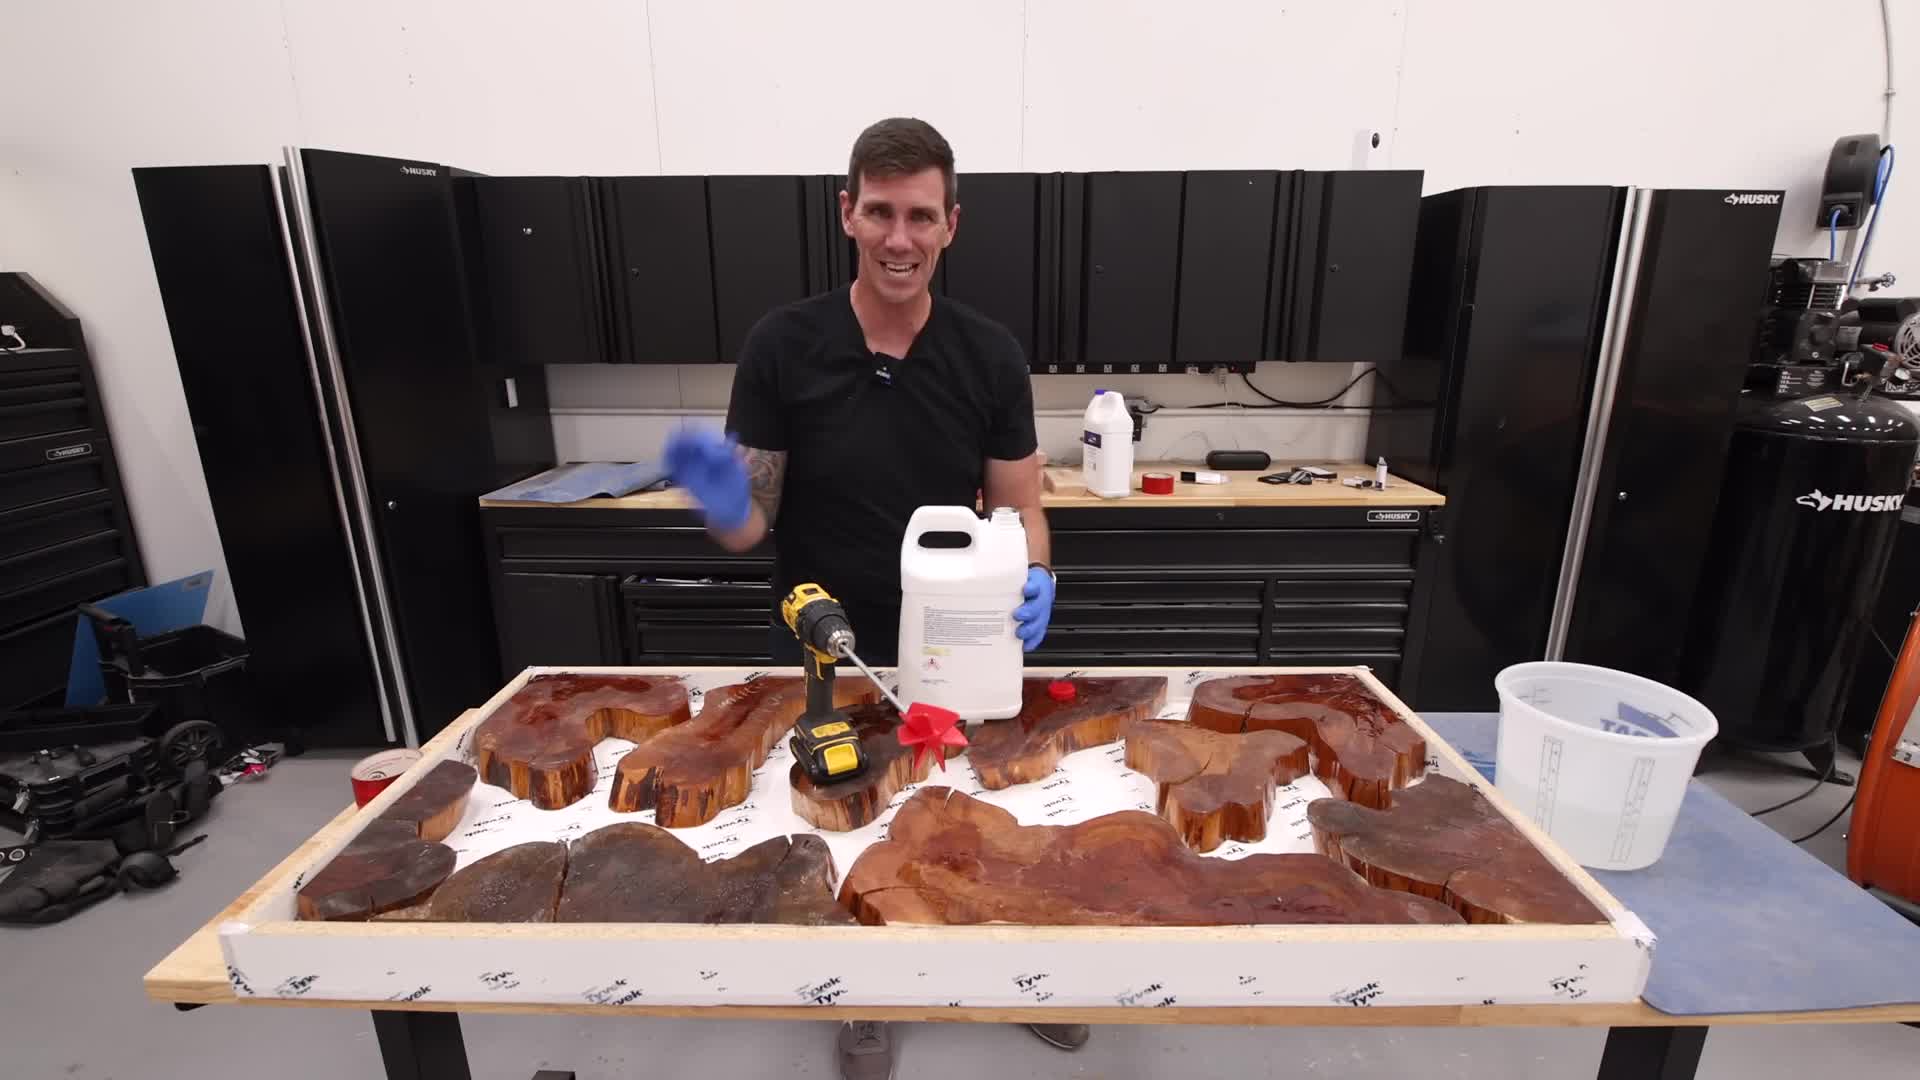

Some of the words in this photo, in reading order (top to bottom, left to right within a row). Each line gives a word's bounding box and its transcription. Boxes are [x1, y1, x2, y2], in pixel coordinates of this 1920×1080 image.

[409, 167, 437, 177] HUSKY
[1739, 194, 1780, 204] HUSKY
[1832, 494, 1905, 512] HUSKY
